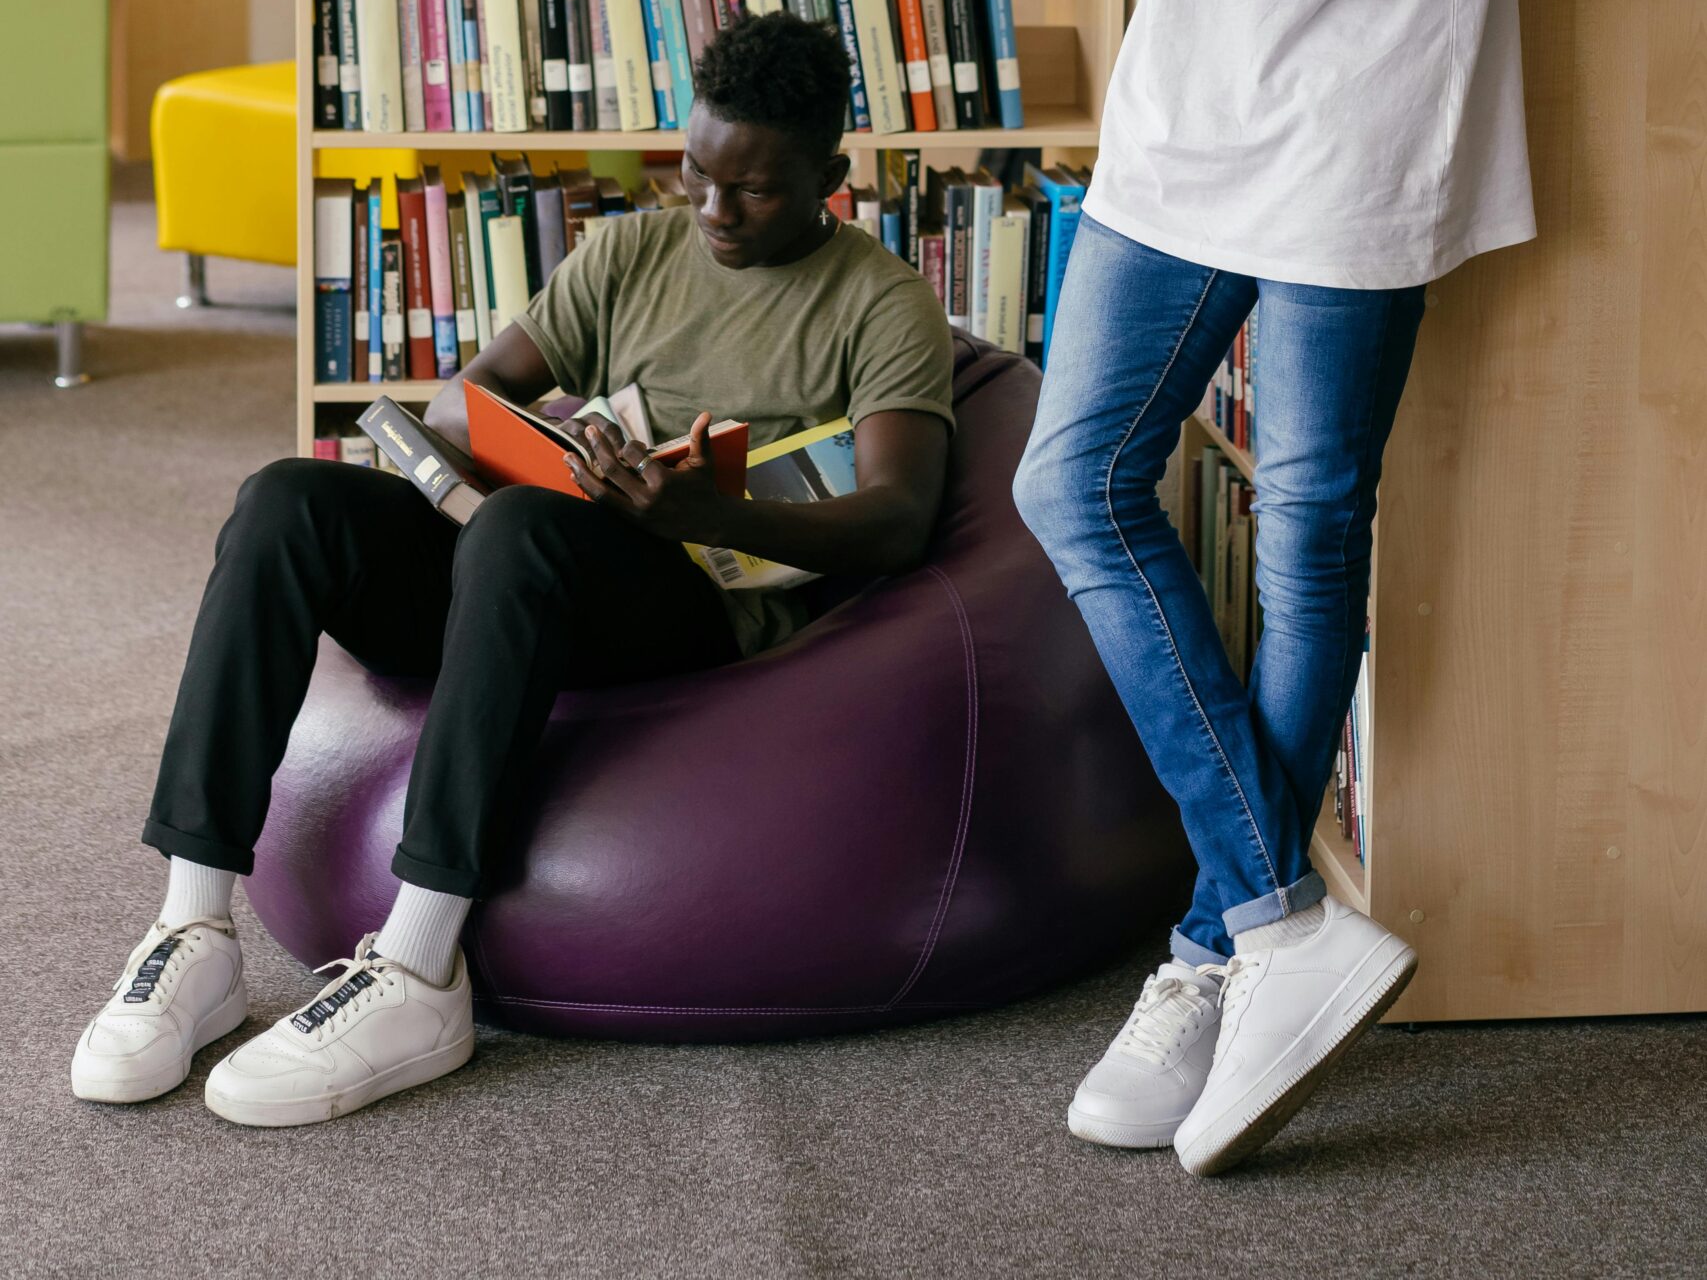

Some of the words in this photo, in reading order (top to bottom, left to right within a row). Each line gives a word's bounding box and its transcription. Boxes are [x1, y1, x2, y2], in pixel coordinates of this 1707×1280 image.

[870, 26, 885, 82] institutions
[378, 93, 391, 131] Change
[879, 95, 893, 131] Culture
[293, 1020, 308, 1033] STYLE
[296, 1014, 313, 1028] URBAN
